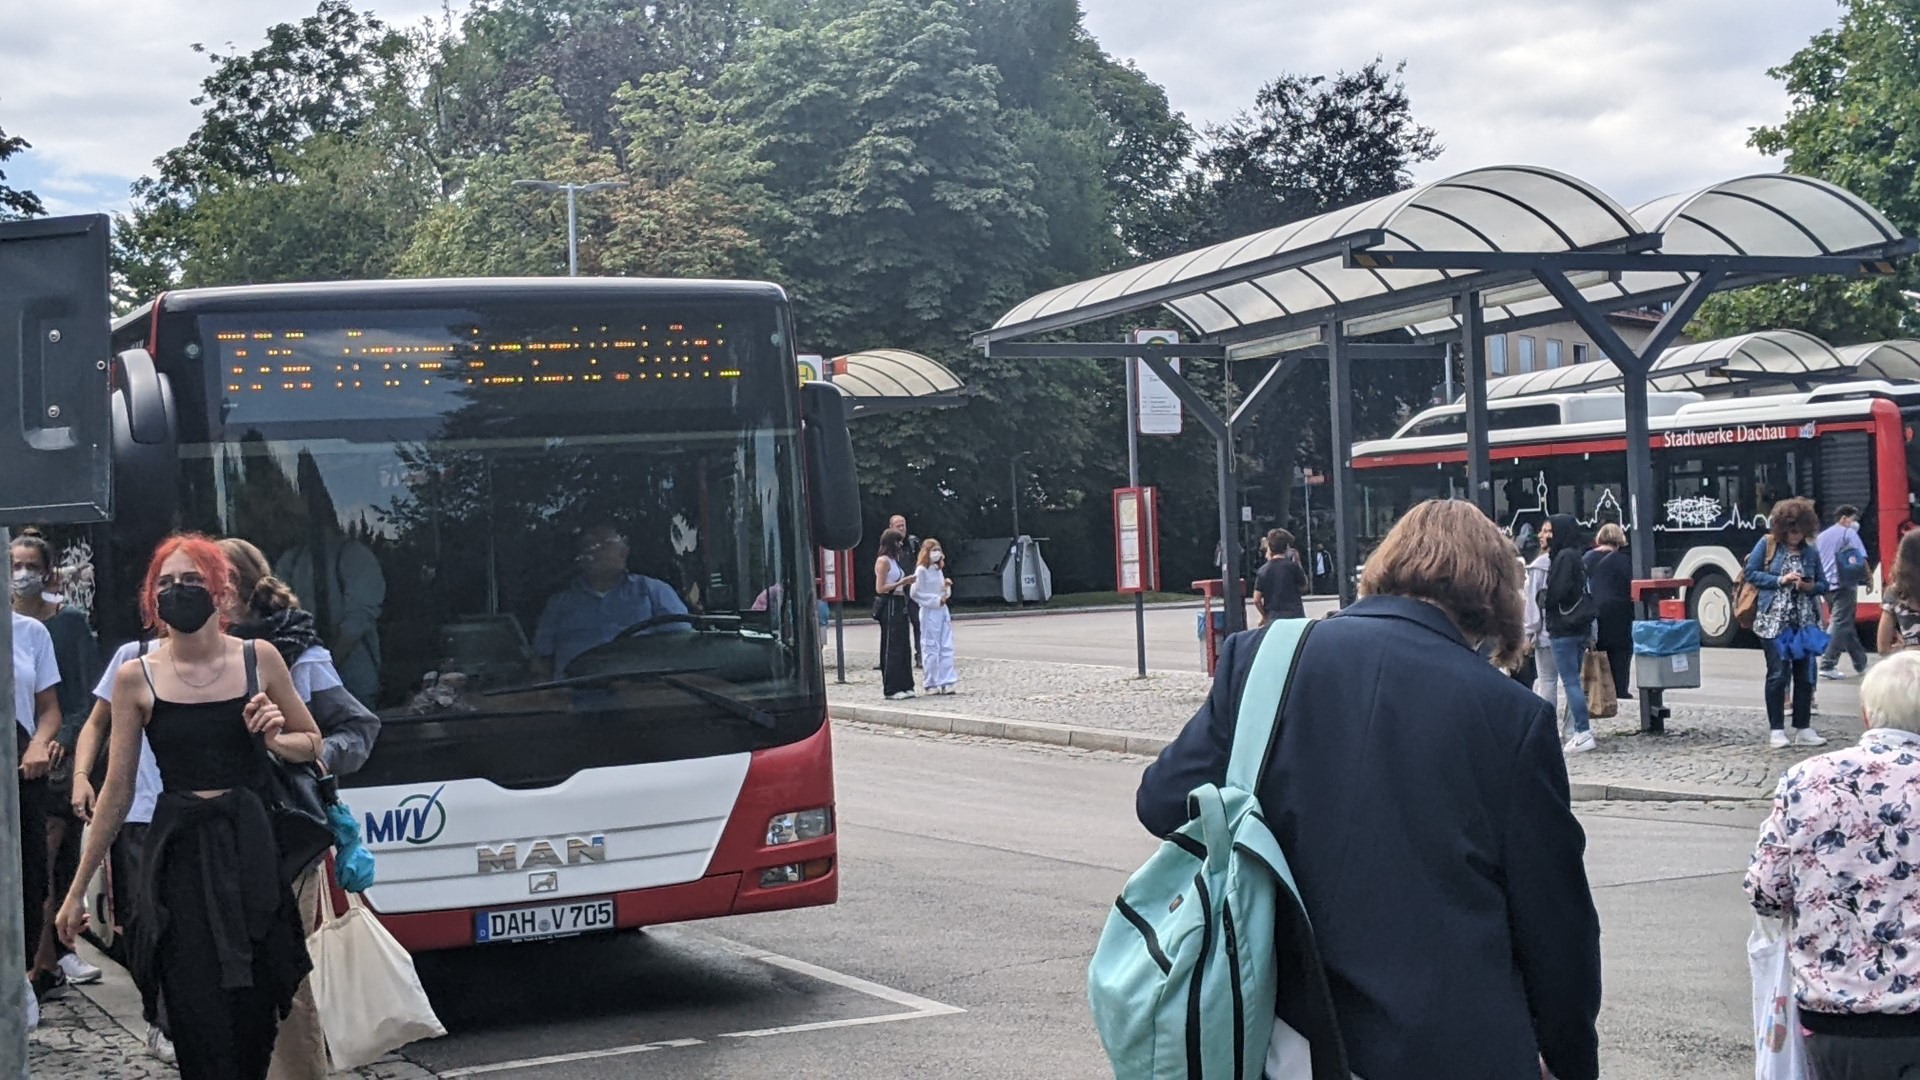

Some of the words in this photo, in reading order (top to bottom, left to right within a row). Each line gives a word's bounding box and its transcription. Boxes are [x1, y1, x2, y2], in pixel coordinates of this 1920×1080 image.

[1664, 427, 1734, 448] Stadtwerke
[1737, 423, 1787, 442] Dachau
[365, 784, 446, 844] MVV
[476, 834, 606, 873] MAN
[491, 911, 536, 936] DAH
[551, 907, 567, 931] V
[570, 902, 612, 928] 705
